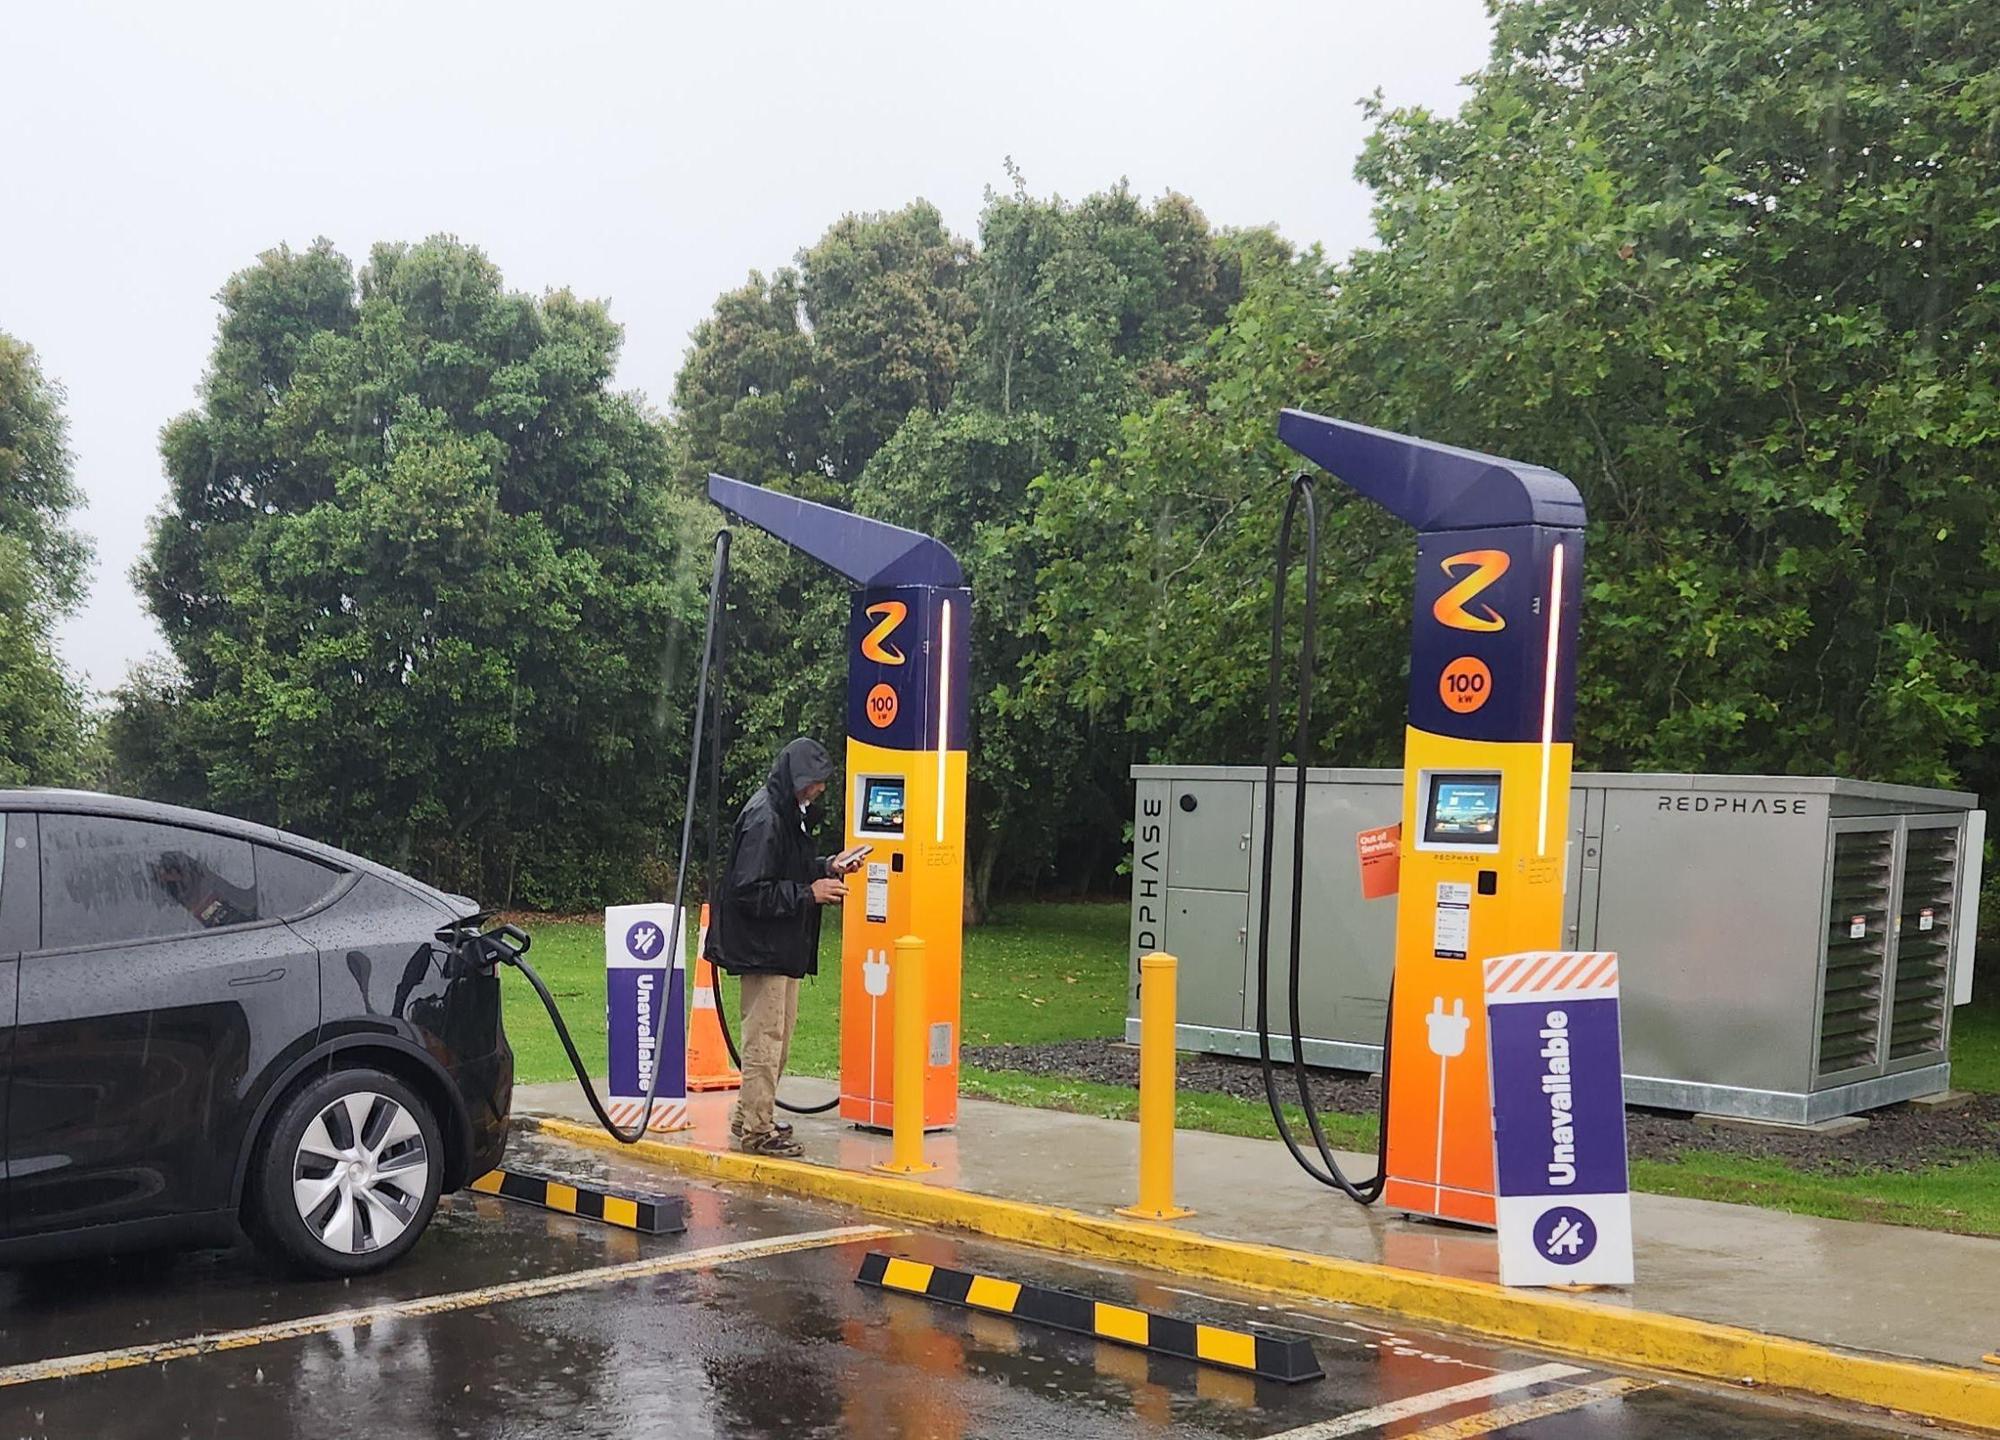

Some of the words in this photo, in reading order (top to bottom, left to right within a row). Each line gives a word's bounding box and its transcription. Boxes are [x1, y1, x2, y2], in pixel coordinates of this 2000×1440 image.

[1432, 549, 1511, 633] Z
[860, 600, 909, 666] Z
[870, 696, 893, 713] 100
[1447, 673, 1485, 693] 100
[1458, 694, 1473, 704] kW
[1658, 796, 1807, 815] REDPHASE
[1359, 835, 1377, 845] Out
[1377, 832, 1387, 841] of
[1136, 799, 1161, 1000] DPHASE
[637, 974, 656, 1091] Unavailable
[1539, 1010, 1576, 1187] Unavailable
